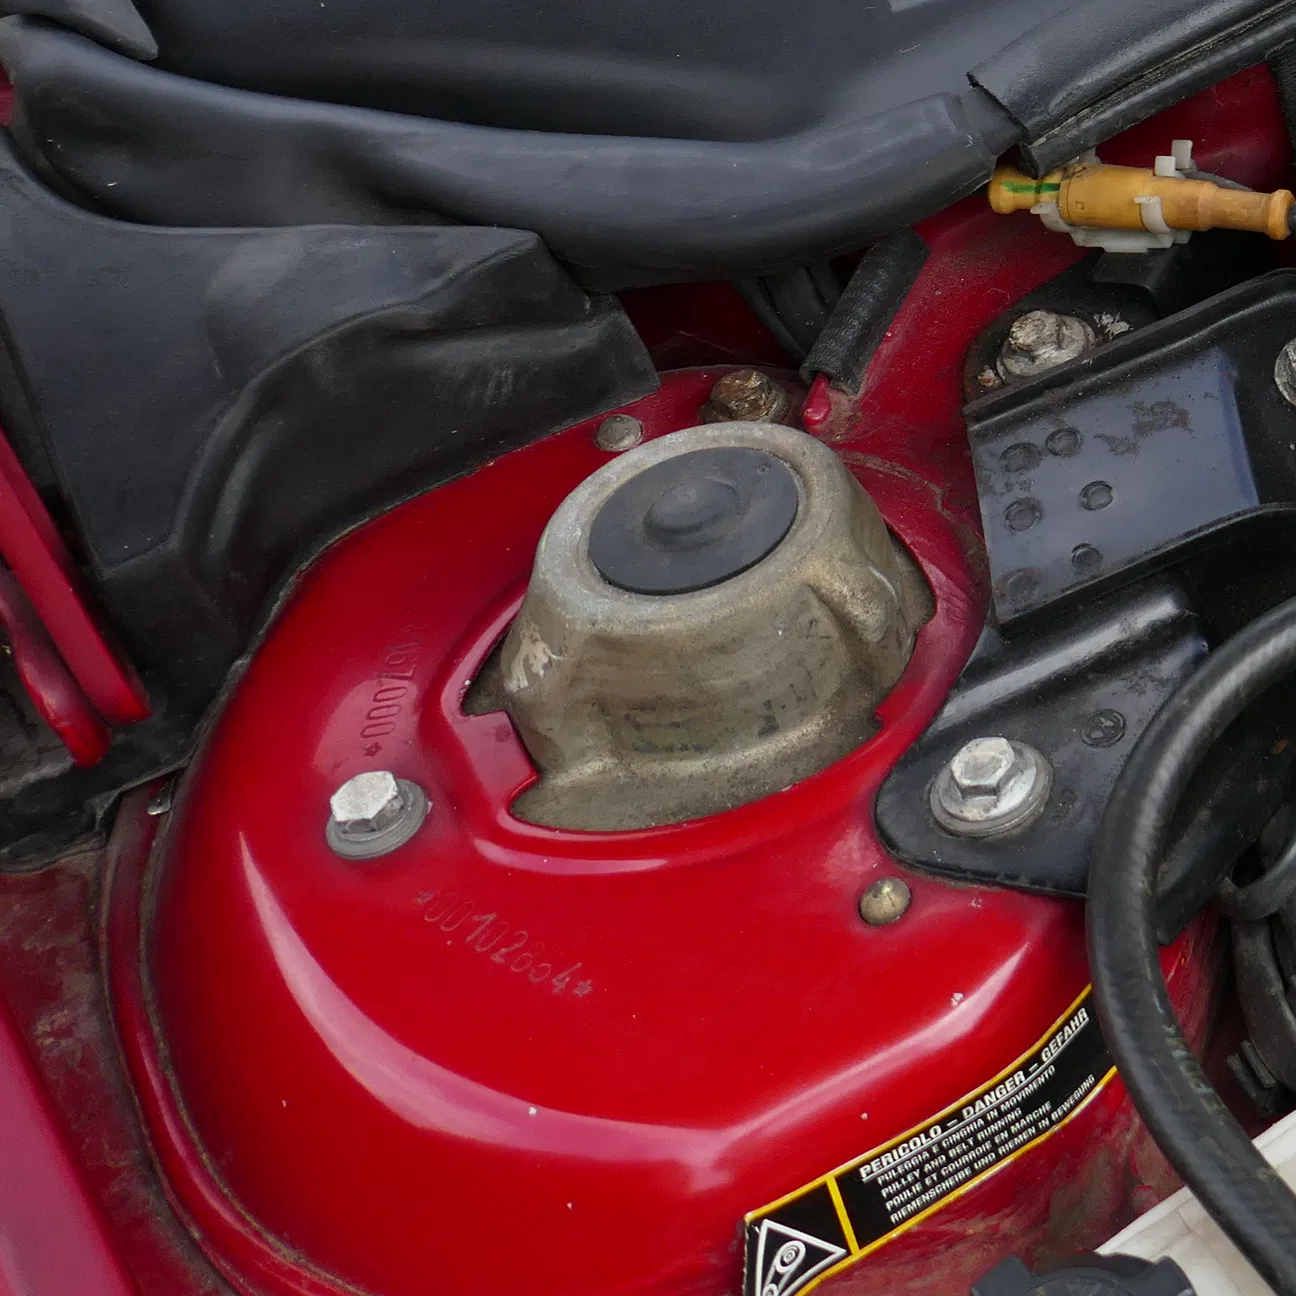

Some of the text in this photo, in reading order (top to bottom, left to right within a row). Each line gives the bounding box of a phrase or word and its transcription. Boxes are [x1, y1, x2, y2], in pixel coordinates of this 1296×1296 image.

[859, 1125, 942, 1178] PERICOLO
[962, 1070, 1026, 1119] DANGER
[1041, 1007, 1088, 1062] GEFAHR
[877, 1065, 1056, 1185] PULEGGIA E CINGHIA IN MOVIMENTO
[890, 1074, 1096, 1224] RIEMENSCHEIBE UND RIEMEN IN BEWEGUNG
[881, 1107, 1022, 1199] PULLEY AND BELT RUNNING
[885, 1101, 1052, 1211] POULIE ET COURROIE EN MARCHE
